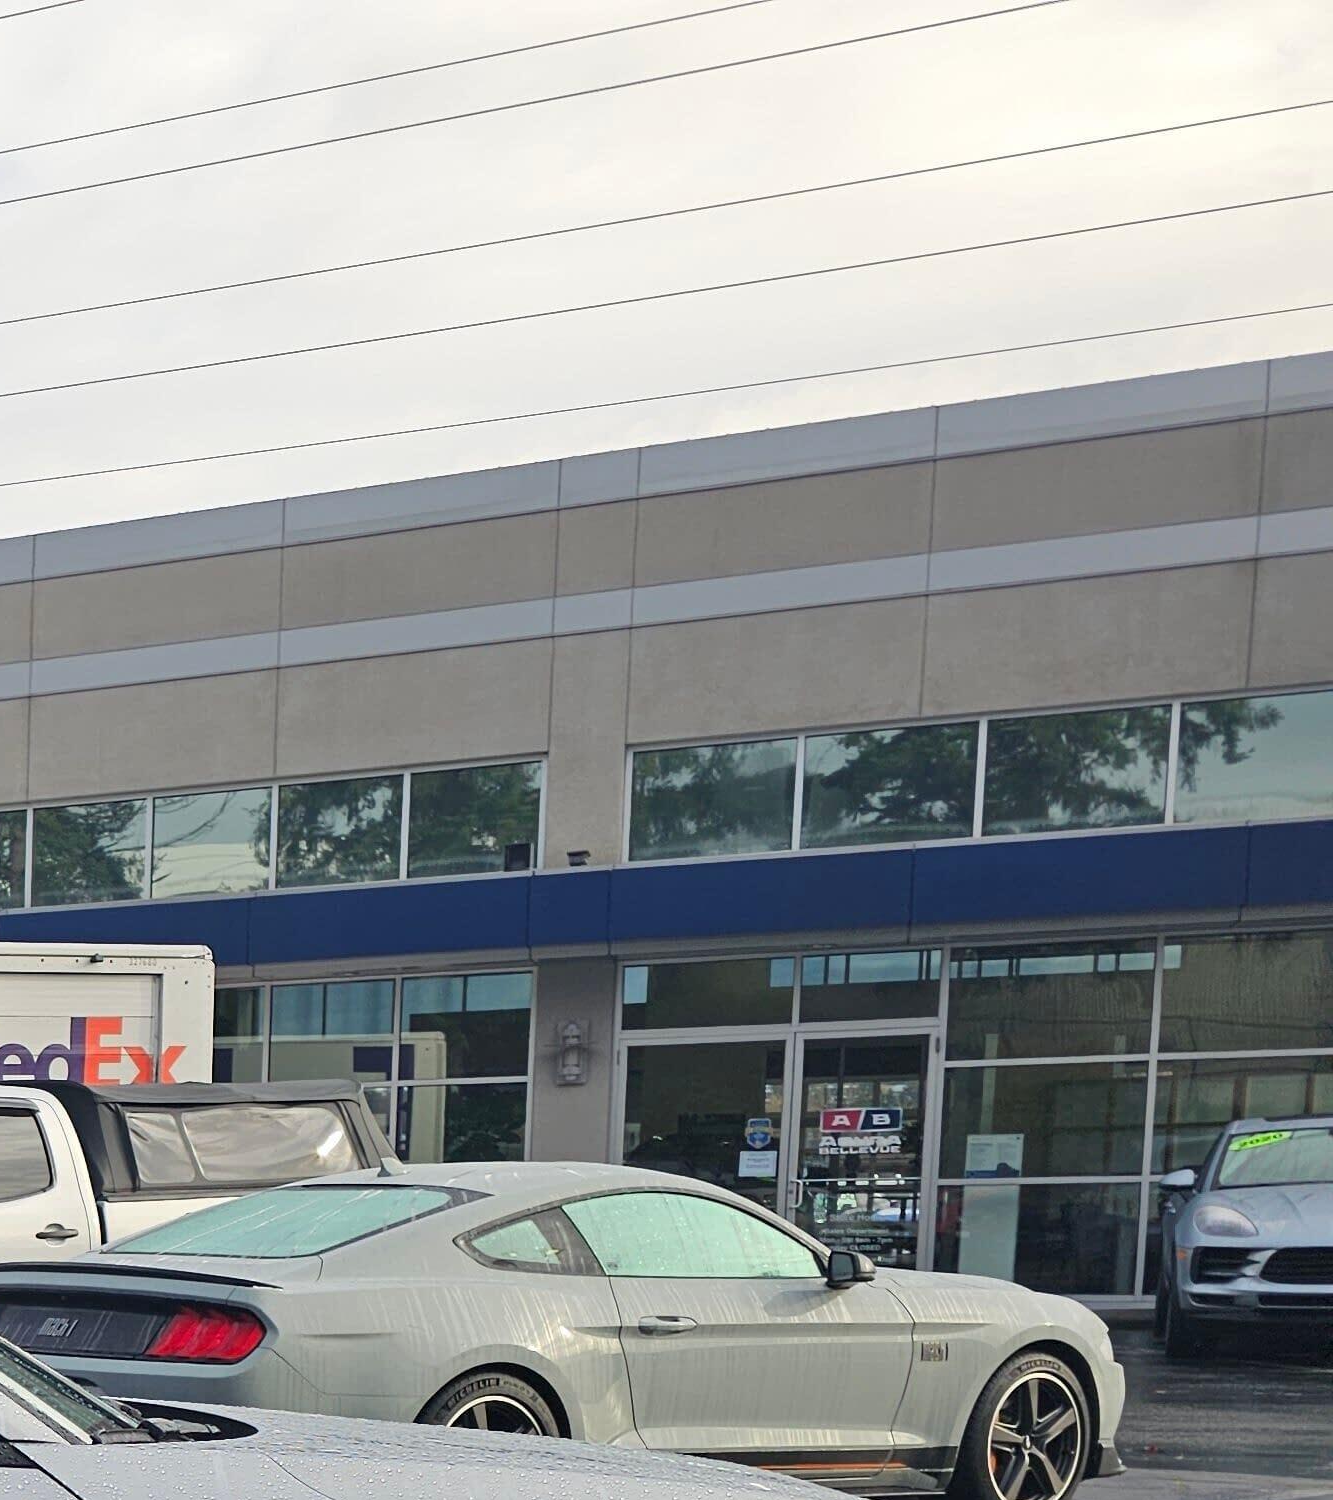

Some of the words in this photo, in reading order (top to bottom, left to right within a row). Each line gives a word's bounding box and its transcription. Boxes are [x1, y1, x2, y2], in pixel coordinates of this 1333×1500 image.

[831, 1114, 850, 1126] A
[872, 1113, 891, 1125] B
[819, 1145, 901, 1155] BELLEVUE
